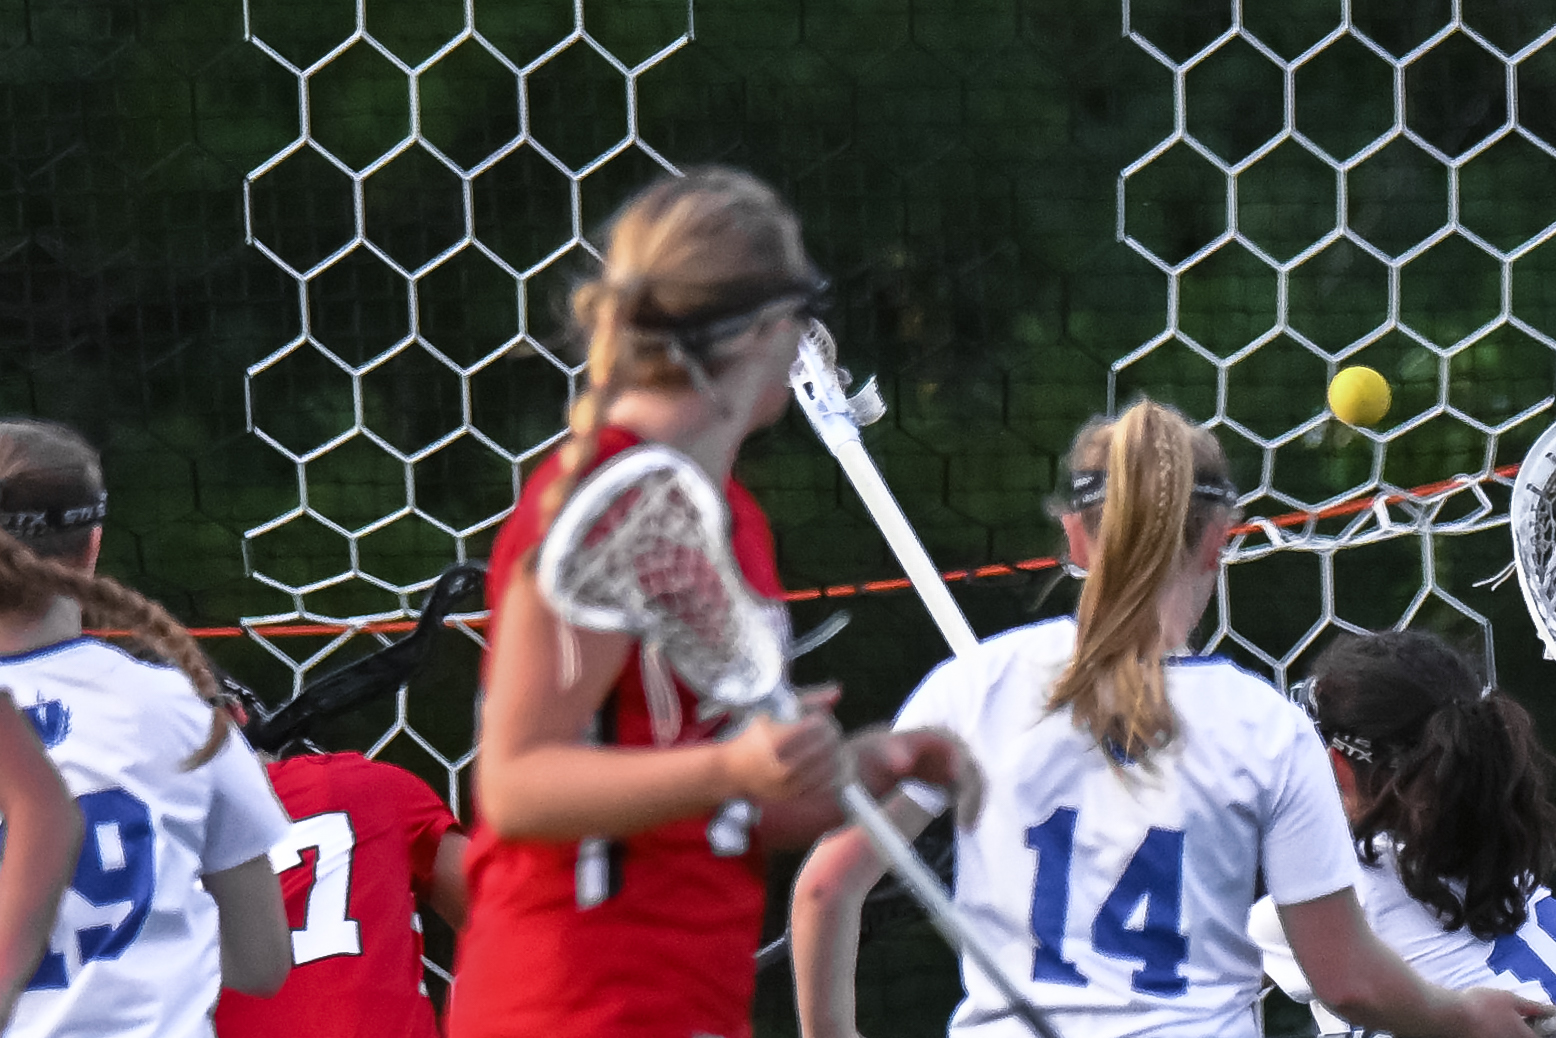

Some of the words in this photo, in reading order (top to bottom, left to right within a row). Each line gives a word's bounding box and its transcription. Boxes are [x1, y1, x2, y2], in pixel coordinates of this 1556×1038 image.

[1331, 736, 1374, 764] STX
[0, 787, 156, 992] 9
[268, 810, 364, 967] 7
[1026, 806, 1190, 998] 14
